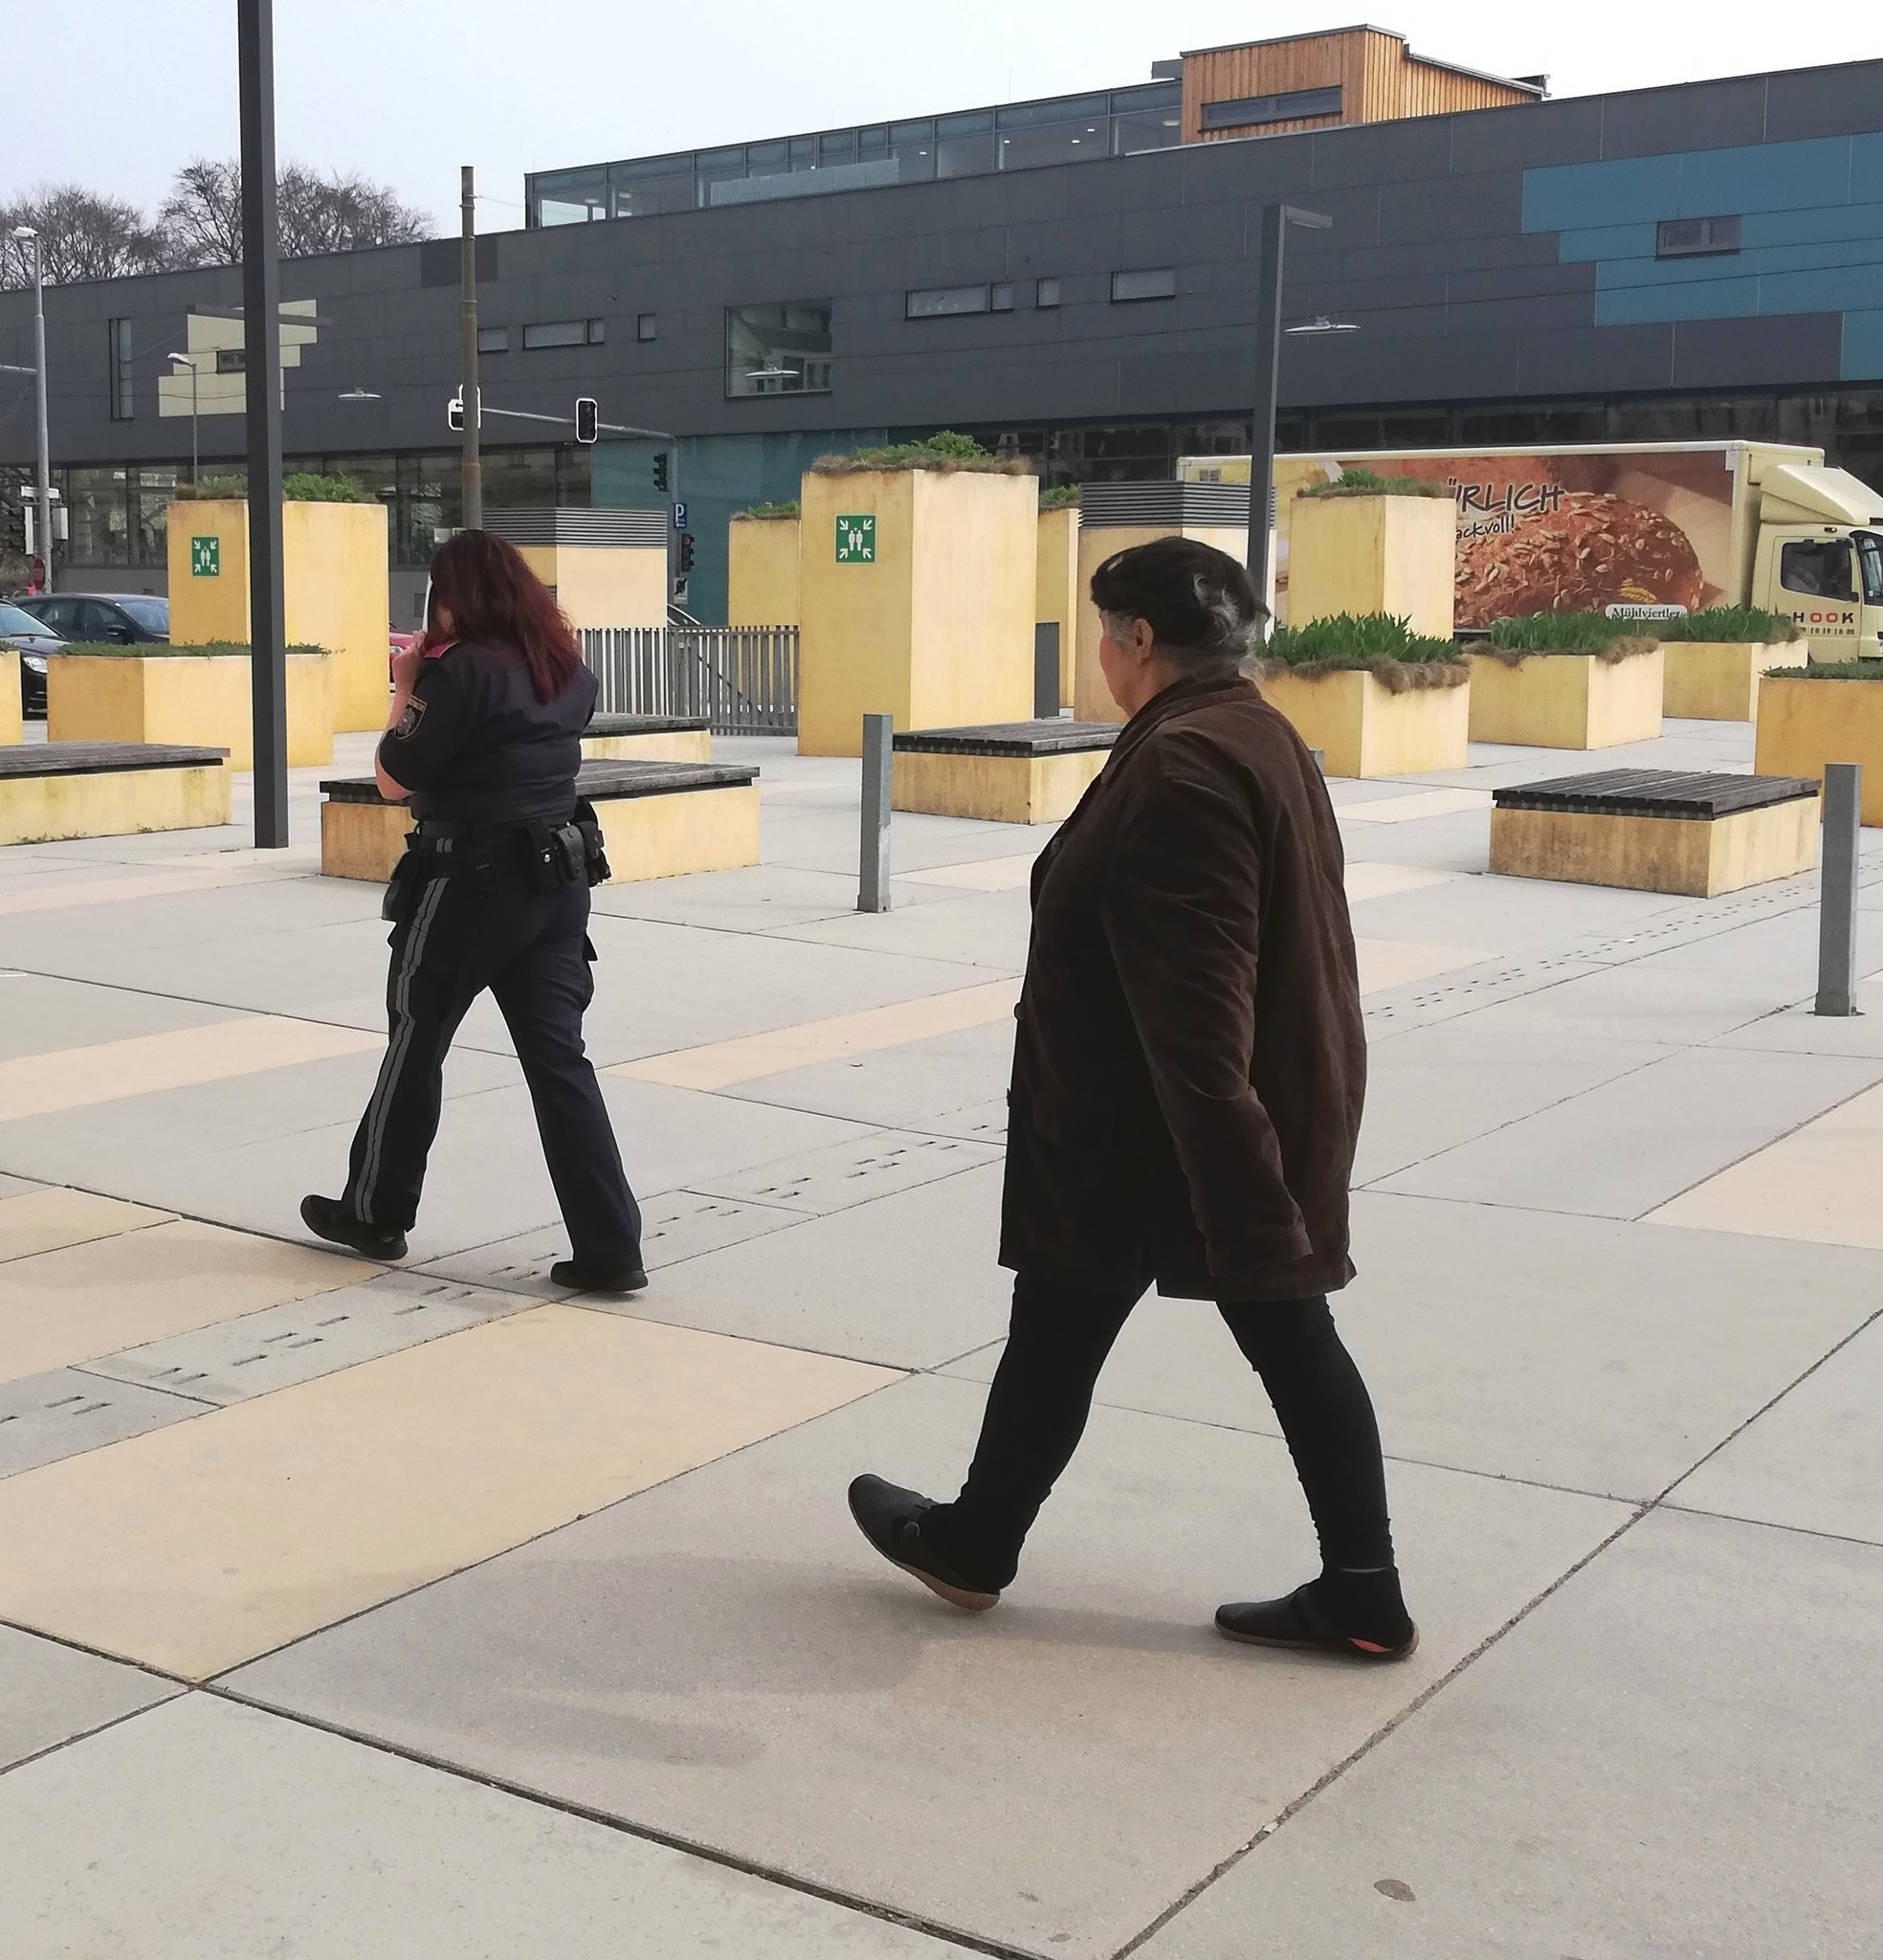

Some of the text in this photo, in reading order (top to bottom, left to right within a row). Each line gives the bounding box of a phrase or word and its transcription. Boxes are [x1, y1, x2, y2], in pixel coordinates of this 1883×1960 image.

[675, 503, 685, 523] P
[1612, 607, 1681, 619] Mühlviertler
[1792, 612, 1854, 624] HOOK
